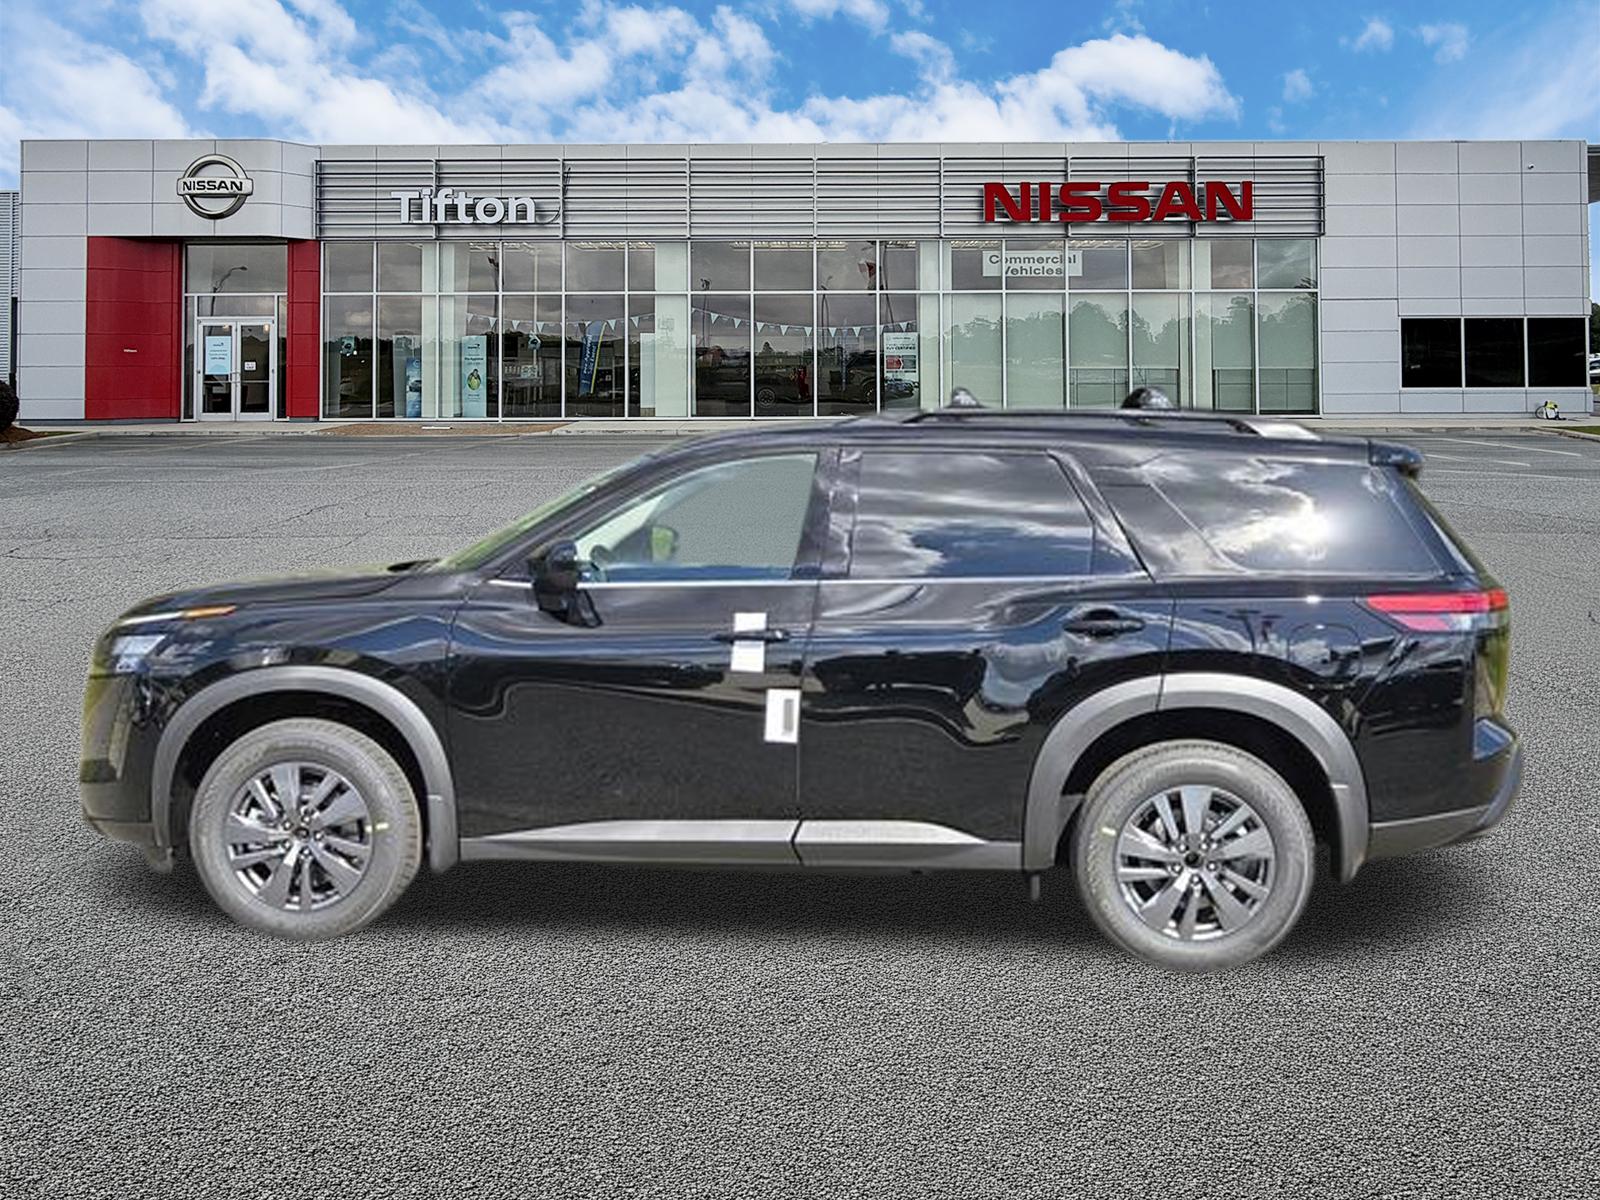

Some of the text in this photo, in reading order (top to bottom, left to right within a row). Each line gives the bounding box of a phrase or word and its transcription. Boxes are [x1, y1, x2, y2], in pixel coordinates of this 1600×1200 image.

[183, 181, 243, 191] NISSAN
[983, 181, 1254, 222] NISSAN
[391, 188, 536, 224] Tifton
